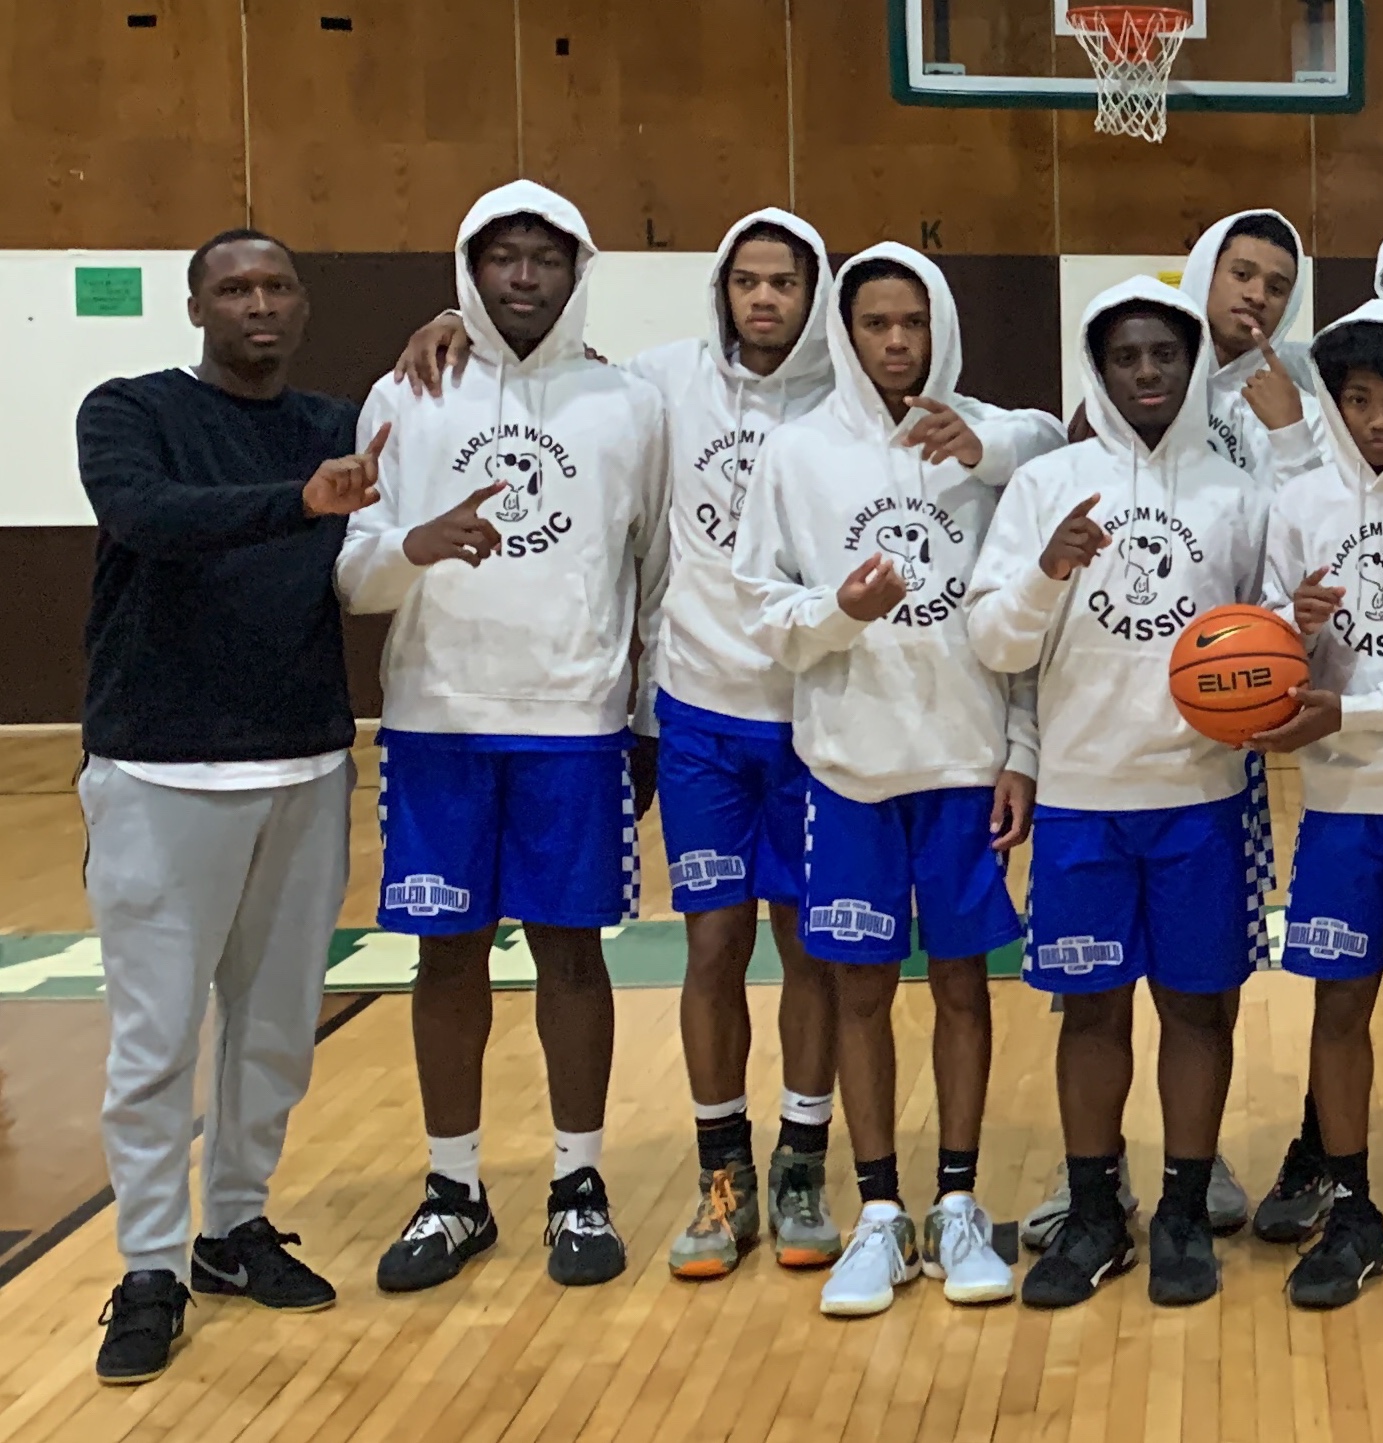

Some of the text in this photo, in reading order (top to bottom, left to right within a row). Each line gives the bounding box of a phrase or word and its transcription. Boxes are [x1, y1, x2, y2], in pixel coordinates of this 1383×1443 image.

[646, 217, 669, 249] L
[920, 219, 943, 250] K
[524, 425, 578, 479] WORLD
[496, 511, 573, 559] SSIC
[1155, 507, 1205, 564] WORLD
[884, 576, 966, 627] ASSIC
[1088, 589, 1197, 642] CLASSIC
[1197, 667, 1273, 693] ELITE
